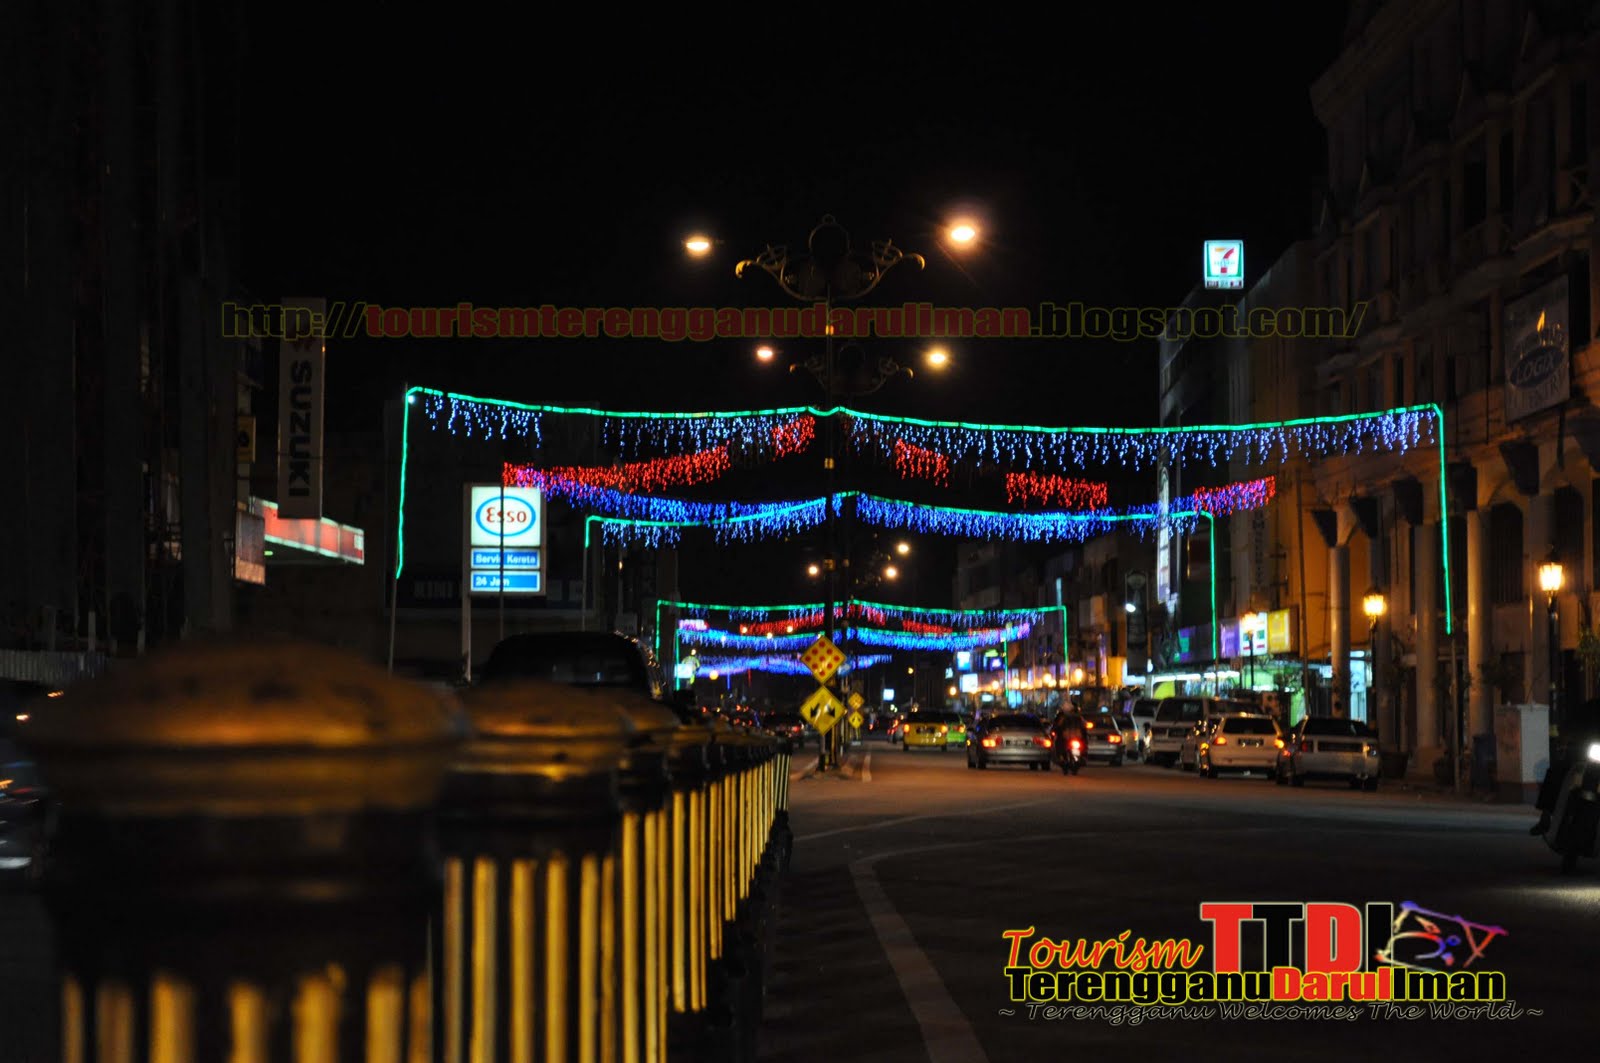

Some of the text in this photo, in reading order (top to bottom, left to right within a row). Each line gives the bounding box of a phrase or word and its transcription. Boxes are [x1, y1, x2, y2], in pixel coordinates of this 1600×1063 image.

[289, 360, 313, 497] SUZUKI
[475, 554, 503, 563] Servi
[475, 576, 487, 586] 24
